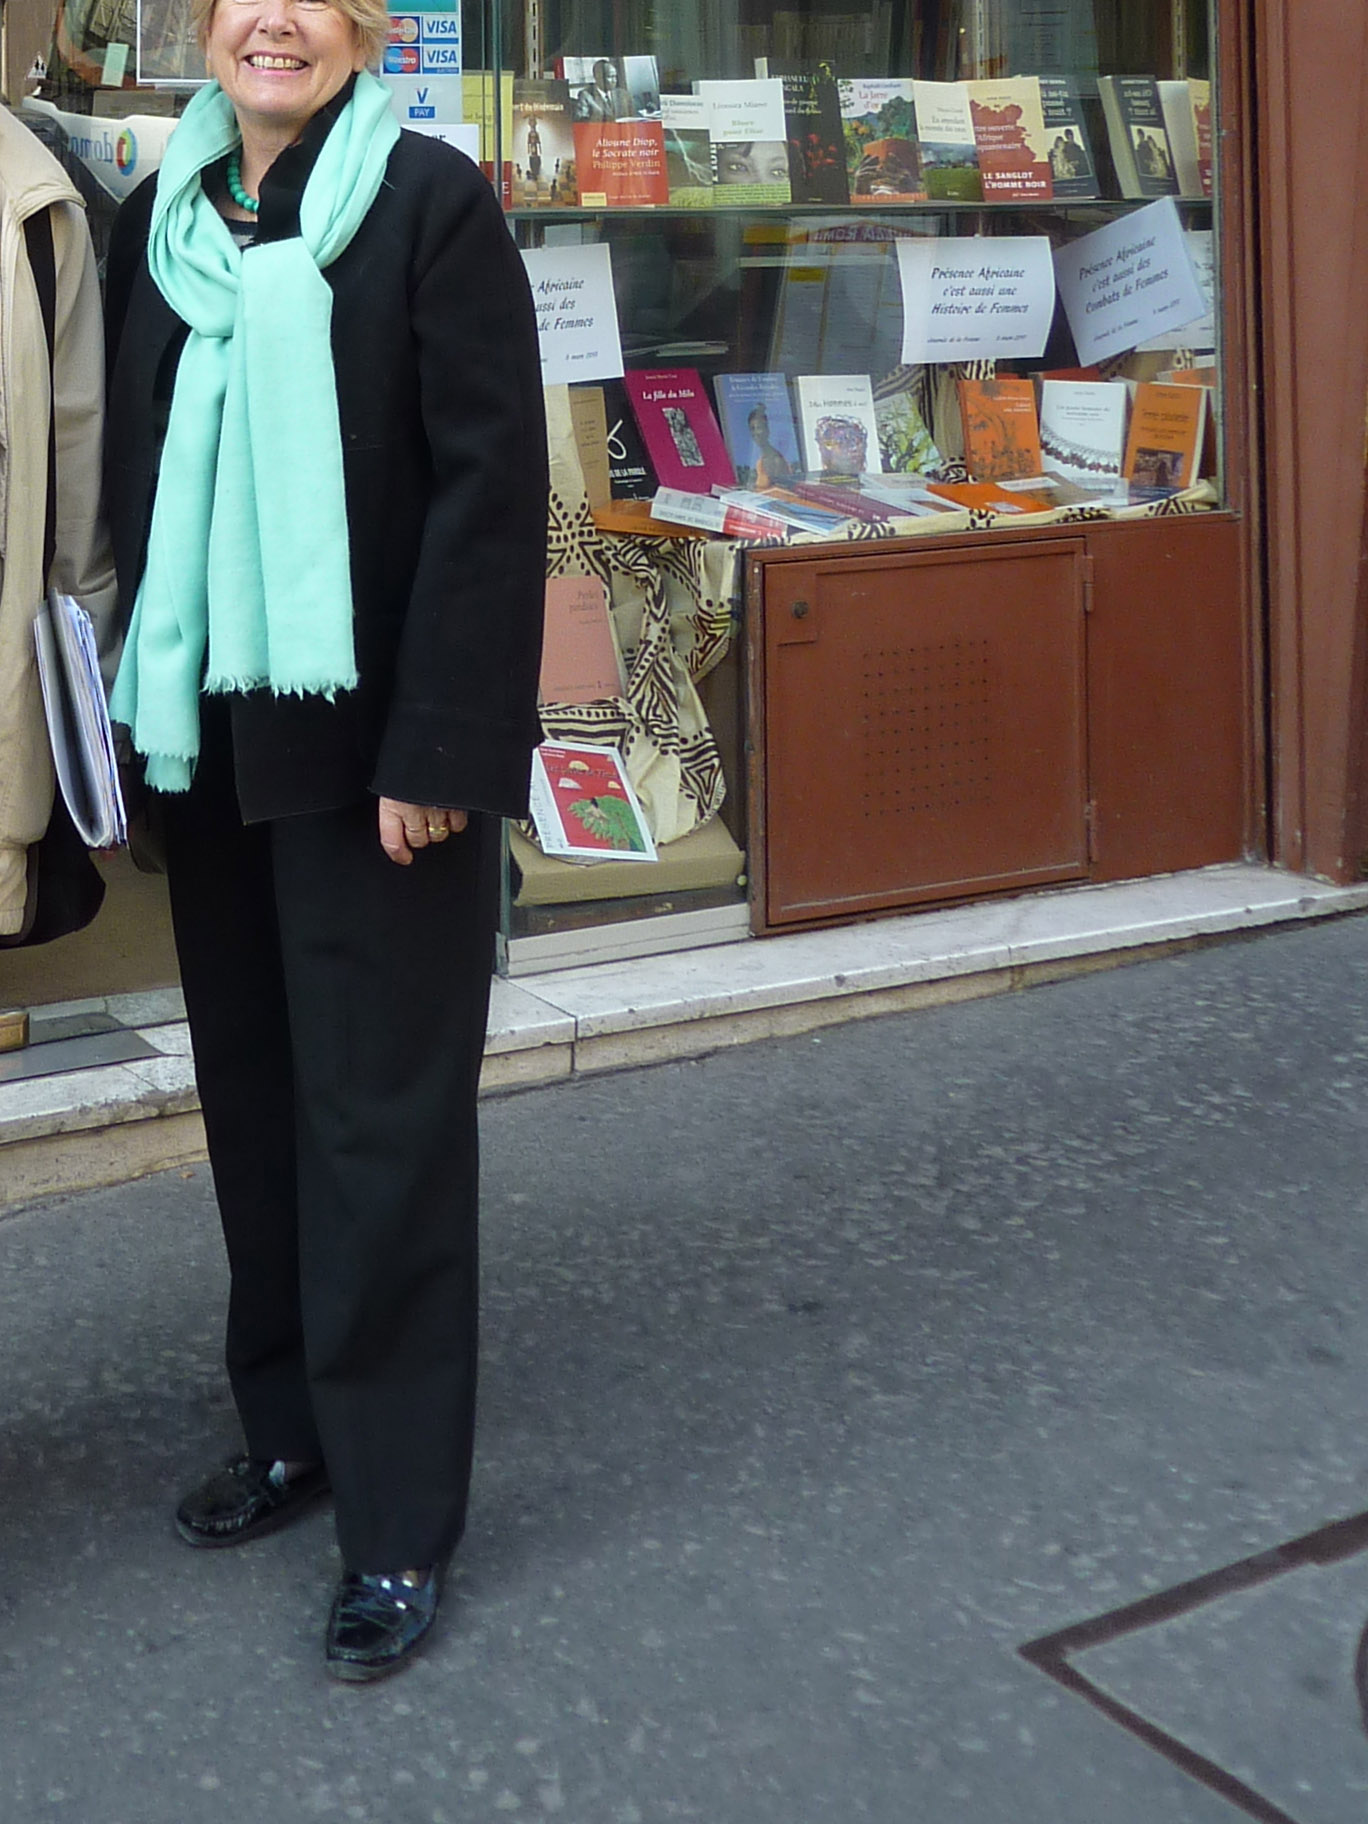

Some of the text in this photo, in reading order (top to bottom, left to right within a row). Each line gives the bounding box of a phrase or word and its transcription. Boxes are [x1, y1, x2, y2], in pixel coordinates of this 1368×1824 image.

[426, 20, 457, 34] VISA
[426, 49, 458, 64] VISA
[413, 108, 431, 118] PAY
[595, 137, 658, 149] Alioune Diop,
[592, 148, 660, 158] le Socrate noir
[592, 160, 661, 170] Philippe Verdin
[1079, 236, 1156, 281] Présence Africaine
[1136, 257, 1151, 271] des
[931, 266, 1026, 281] Présence Africaine
[537, 278, 585, 295] Africaine
[968, 284, 995, 296] aussi
[1085, 268, 1169, 314] Combats de Femmes
[559, 297, 576, 310] des
[931, 301, 1030, 315] Histoire de Femmes
[538, 316, 594, 331] de Femmes
[642, 391, 678, 402] La fille du
